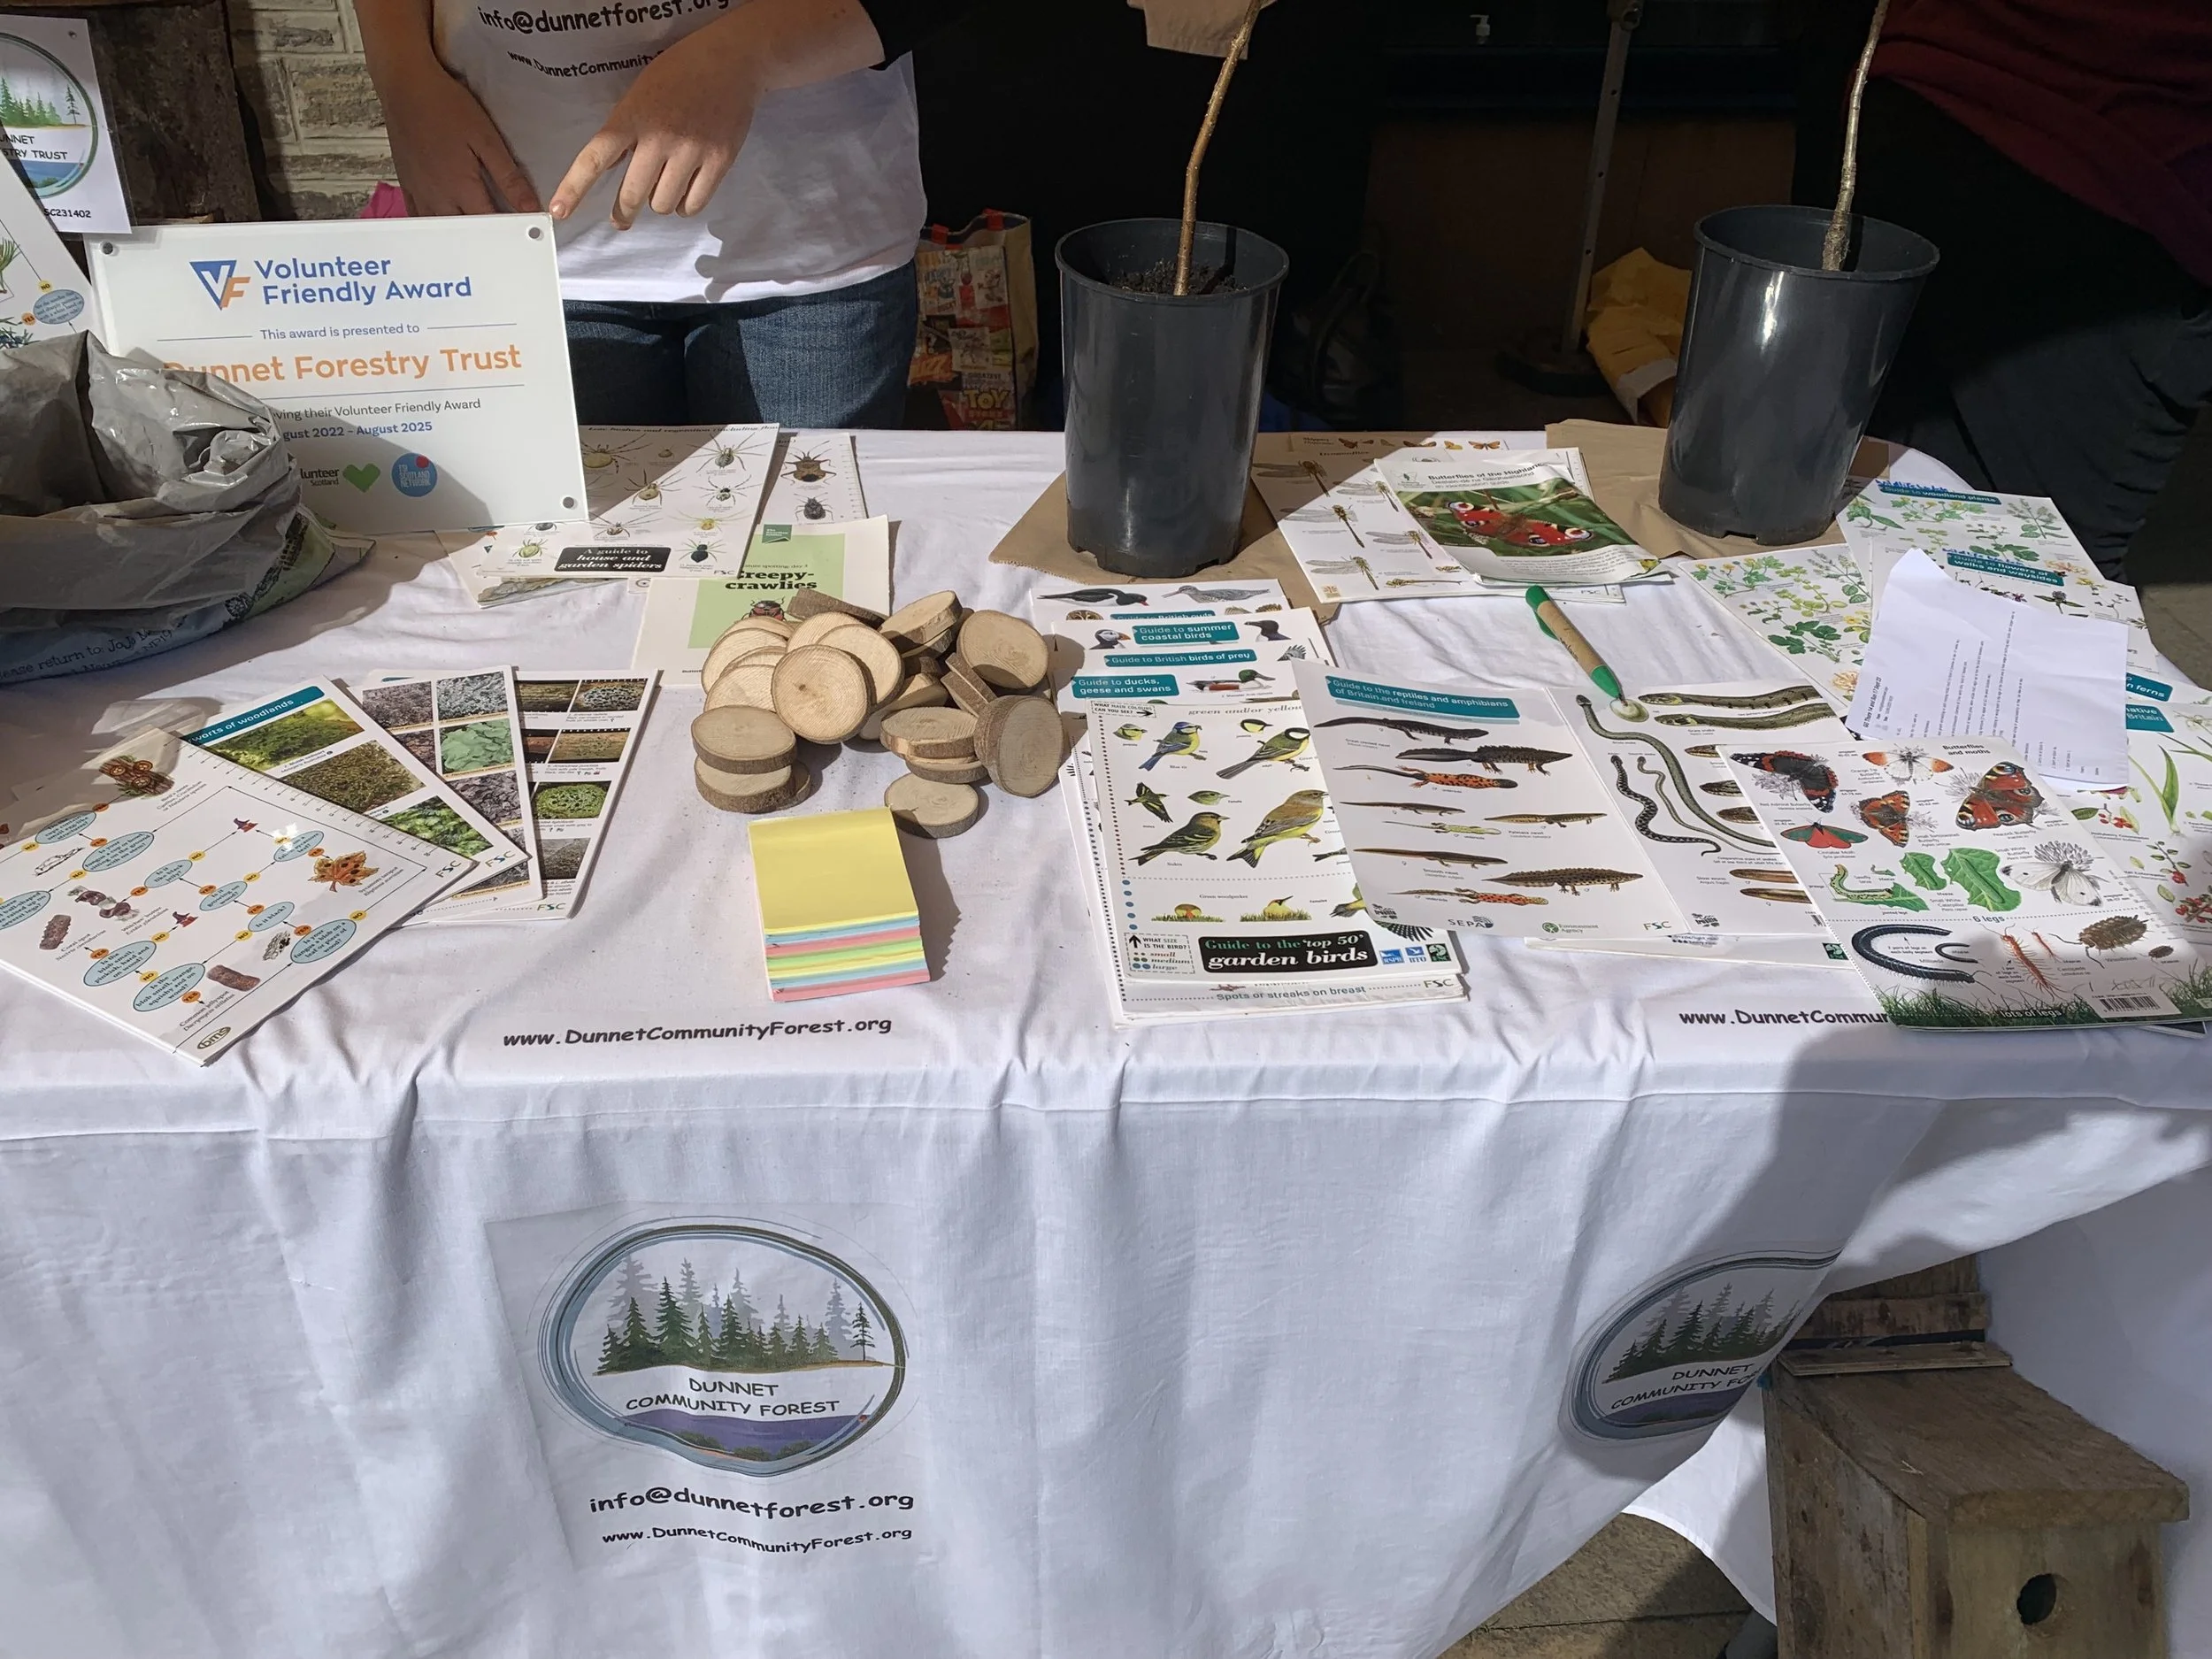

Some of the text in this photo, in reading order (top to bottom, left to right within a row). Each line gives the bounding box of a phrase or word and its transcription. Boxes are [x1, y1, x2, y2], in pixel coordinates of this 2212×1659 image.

[34, 150, 68, 161] TRUST
[254, 256, 390, 280] Volunteer
[263, 277, 472, 306] Friendly Award
[260, 323, 419, 341] This award is presented to
[295, 350, 429, 380] Forestry
[440, 344, 522, 372] Trust
[962, 388, 1010, 410] TOY
[304, 408, 332, 419] their
[334, 404, 392, 417] Volunteer
[395, 400, 442, 414] Friendly
[444, 398, 480, 411] Award
[312, 426, 344, 438] 2022
[357, 425, 398, 437] August
[401, 421, 433, 433] 2025
[1923, 490, 1998, 503] woodland plants
[1954, 559, 1985, 570] walks
[2008, 569, 2059, 584] waysides
[1998, 562, 2035, 574] flowers
[725, 581, 818, 590] crawlies
[1184, 631, 1212, 640] birds
[1187, 624, 1233, 633] summer
[38, 651, 85, 673] return
[1155, 655, 1187, 664] British
[1189, 653, 1214, 663] birds
[1228, 652, 1250, 662] prey
[1079, 687, 1111, 695] geese
[1125, 678, 1160, 687] ducks,
[2136, 685, 2165, 697] ferns
[1333, 680, 1361, 691] Guide
[1374, 686, 1391, 695] the
[1392, 689, 1429, 702] reptiles
[1431, 694, 1449, 704] and
[1451, 696, 1509, 708] amphibians
[1335, 687, 1435, 709] of Britain and Ireland
[226, 720, 236, 731] of
[238, 699, 295, 726] woodlands
[485, 849, 517, 868] FSC
[434, 859, 463, 878] FSC
[536, 902, 566, 911] FSC
[1448, 918, 1486, 928] SEPA
[1643, 921, 1671, 930] FSC
[1983, 915, 2006, 924] legs
[155, 933, 166, 942] NO
[1205, 940, 1249, 949] Guide
[1277, 939, 1301, 949] the
[93, 949, 107, 958] YES
[1208, 948, 1369, 970] garden birds
[135, 965, 196, 1008] blob small, orange,
[158, 976, 170, 985] the
[1267, 989, 1310, 999] streaks
[1329, 986, 1367, 995] breast
[1424, 979, 1454, 988] FSC
[148, 987, 175, 1007] squishy
[174, 979, 187, 988] and
[167, 983, 189, 999] wood?
[183, 991, 198, 1002] YES
[179, 1007, 206, 1027] Common
[2038, 1010, 2062, 1018] legs
[503, 1018, 892, 1047] www.DunnetCommunityForest.org
[1671, 1363, 1755, 1381] DUNNET
[688, 1378, 779, 1397] DUNNET
[1610, 1380, 1721, 1409] COMMUNITY
[626, 1394, 840, 1417] COMMUNITY FOREST
[590, 1486, 914, 1519] info@dunnetforest.org
[603, 1526, 912, 1554] www.DunnetCommunityForest.org
